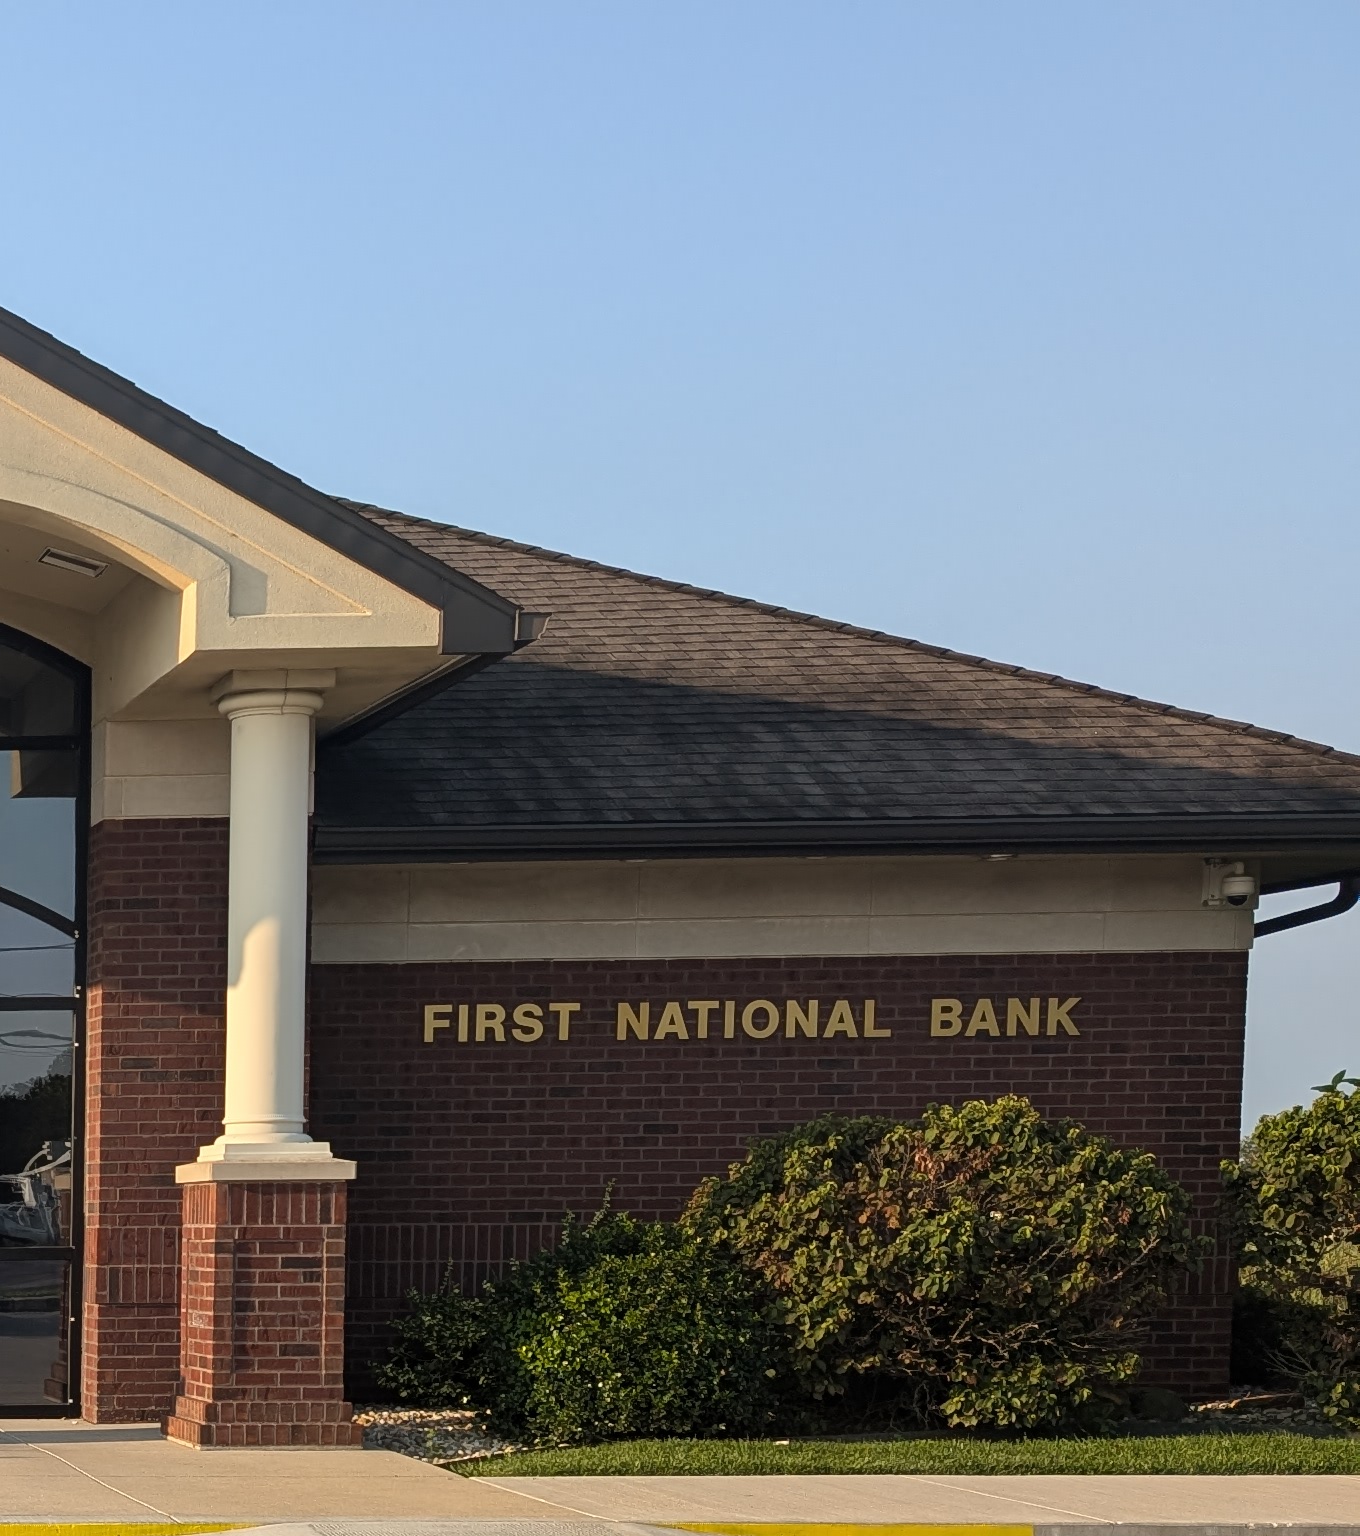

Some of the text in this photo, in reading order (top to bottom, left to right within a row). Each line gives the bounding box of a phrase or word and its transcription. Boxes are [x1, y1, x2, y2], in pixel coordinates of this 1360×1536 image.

[423, 996, 1082, 1043] FIRST NATIONAL BANK
